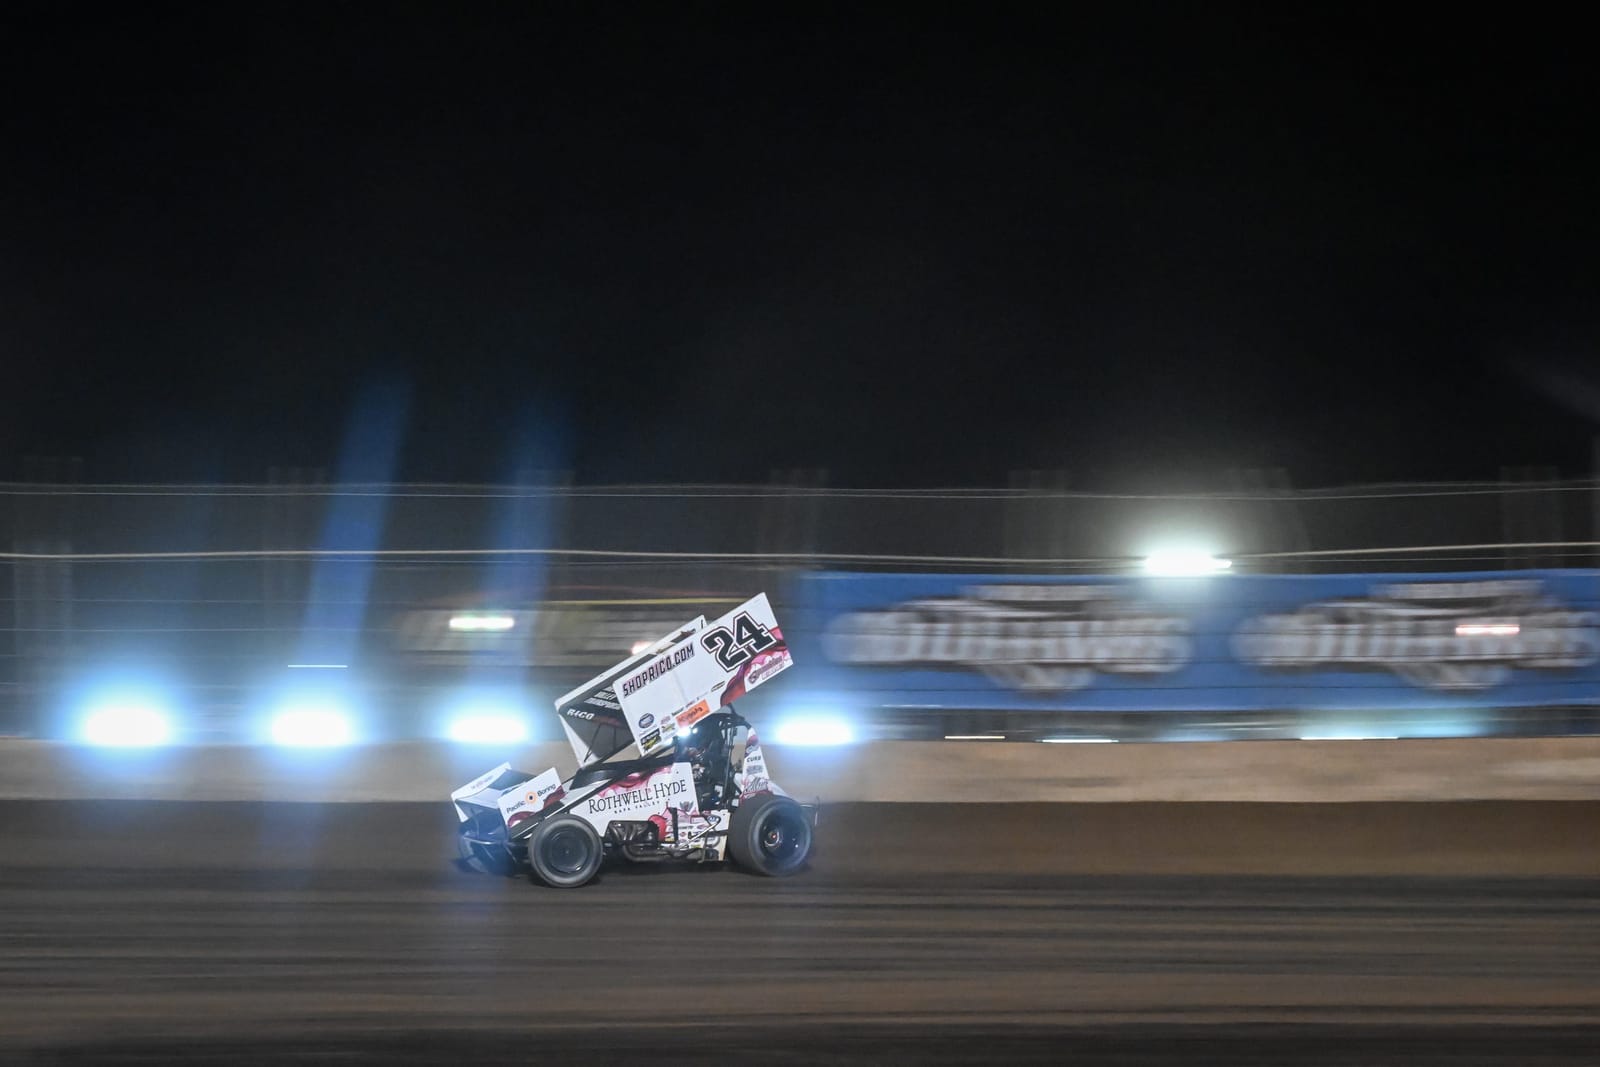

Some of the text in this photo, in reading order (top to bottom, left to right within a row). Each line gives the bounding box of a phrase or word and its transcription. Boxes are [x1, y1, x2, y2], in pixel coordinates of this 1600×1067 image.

[701, 611, 777, 673] 24
[622, 642, 695, 698] SHOPRICO.COM
[566, 708, 595, 720] RICO
[506, 783, 557, 813] Pacific Boring
[588, 779, 687, 814] ROTHWELL HYDE
